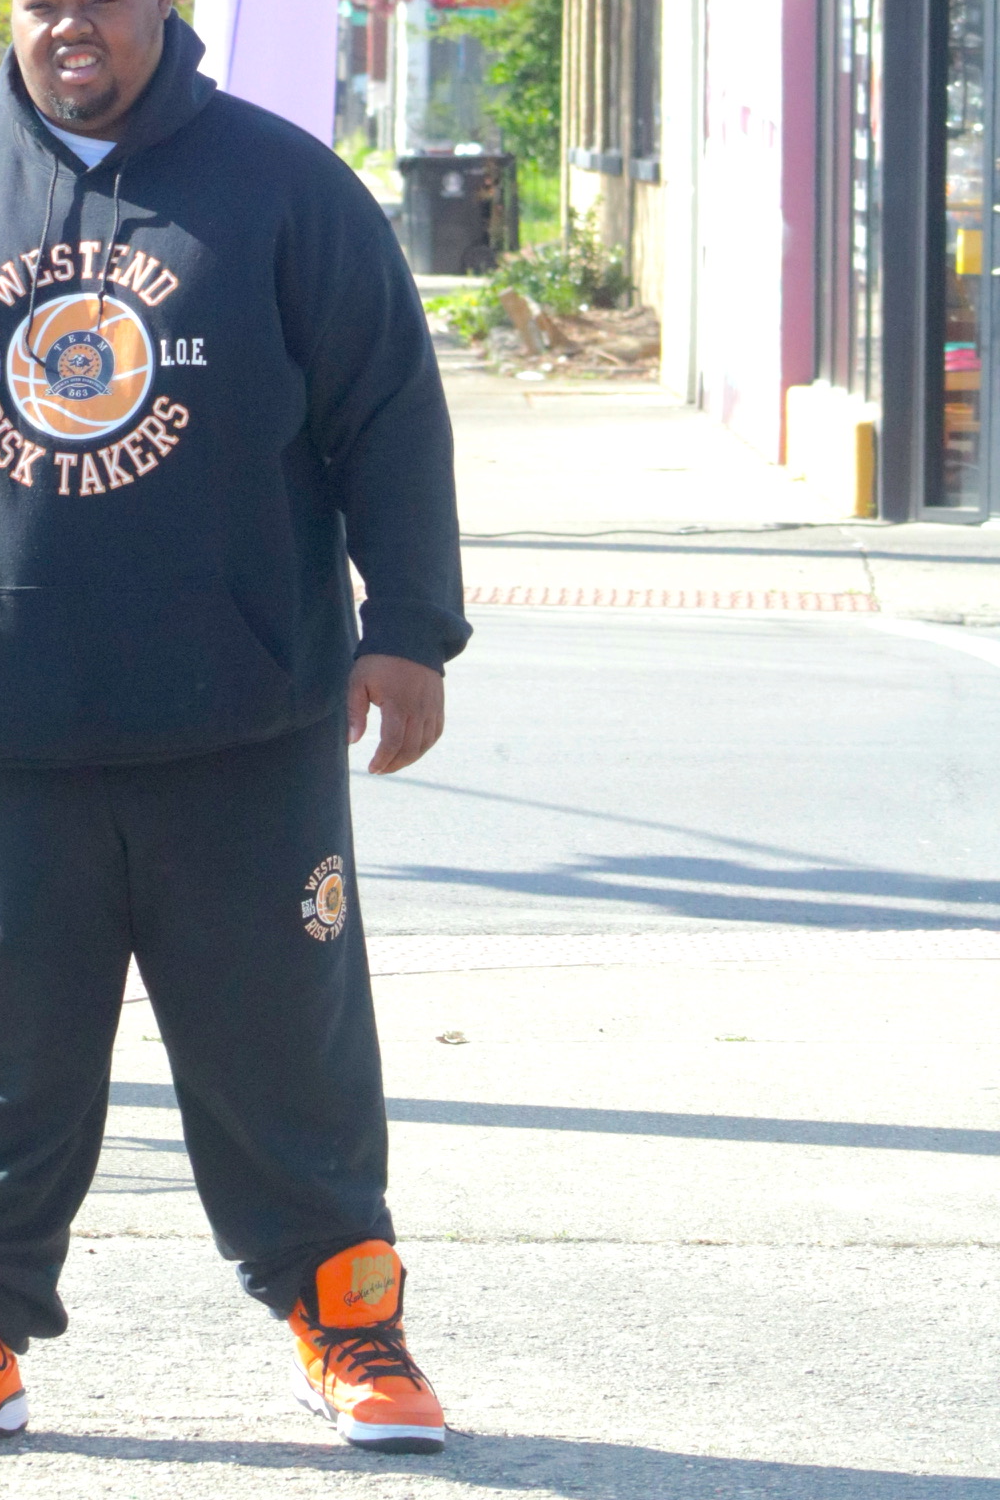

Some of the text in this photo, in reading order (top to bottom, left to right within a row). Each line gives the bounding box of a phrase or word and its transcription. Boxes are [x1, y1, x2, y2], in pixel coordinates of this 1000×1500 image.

[53, 334, 109, 352] TEAM
[160, 338, 208, 366] L.O.E.
[54, 395, 190, 497] TAKERS
[304, 918, 329, 942] RISK
